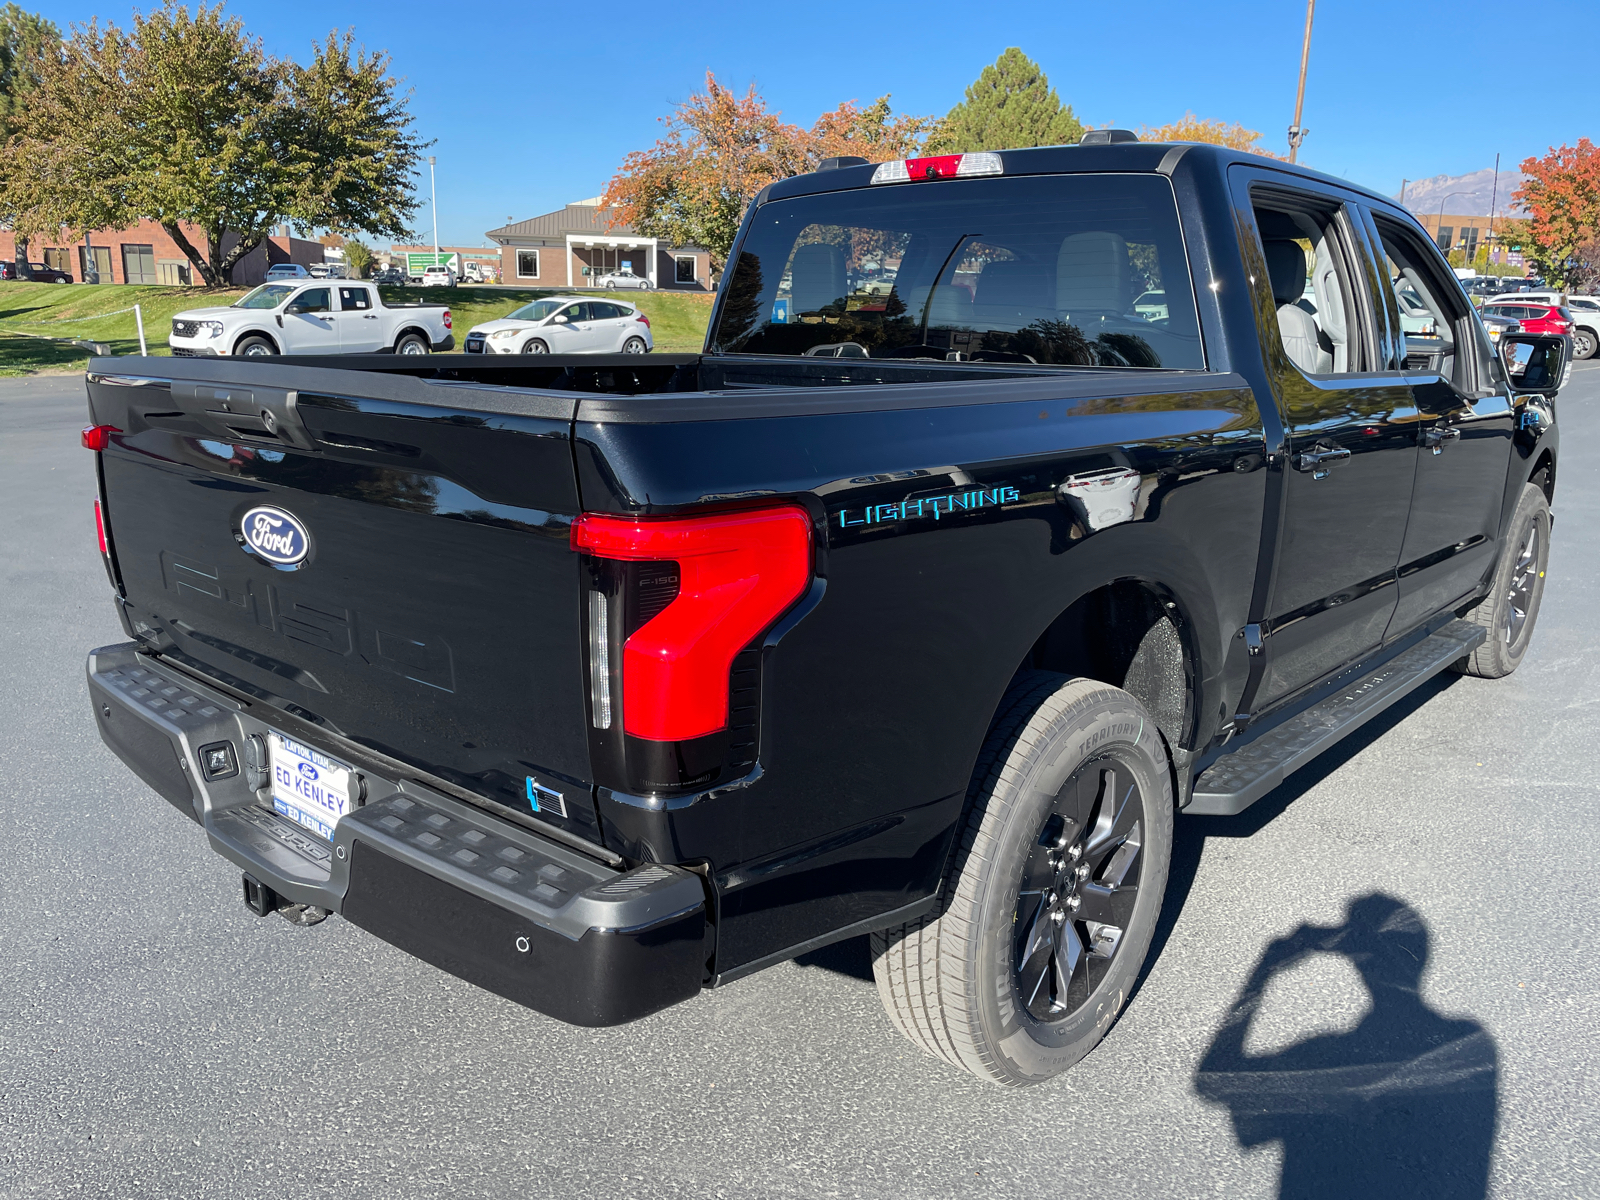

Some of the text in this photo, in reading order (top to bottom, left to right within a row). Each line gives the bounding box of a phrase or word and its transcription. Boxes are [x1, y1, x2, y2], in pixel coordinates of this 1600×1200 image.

[839, 486, 1020, 528] LIGHTNING
[250, 511, 295, 558] Ford
[639, 575, 678, 587] F-150
[1079, 723, 1136, 756] TERRITORY
[300, 763, 317, 781] Ford
[312, 751, 329, 769] UTAH
[276, 766, 291, 787] ED
[295, 775, 344, 815] KENLEY
[288, 804, 299, 822] ED
[300, 812, 332, 840] KENLEY
